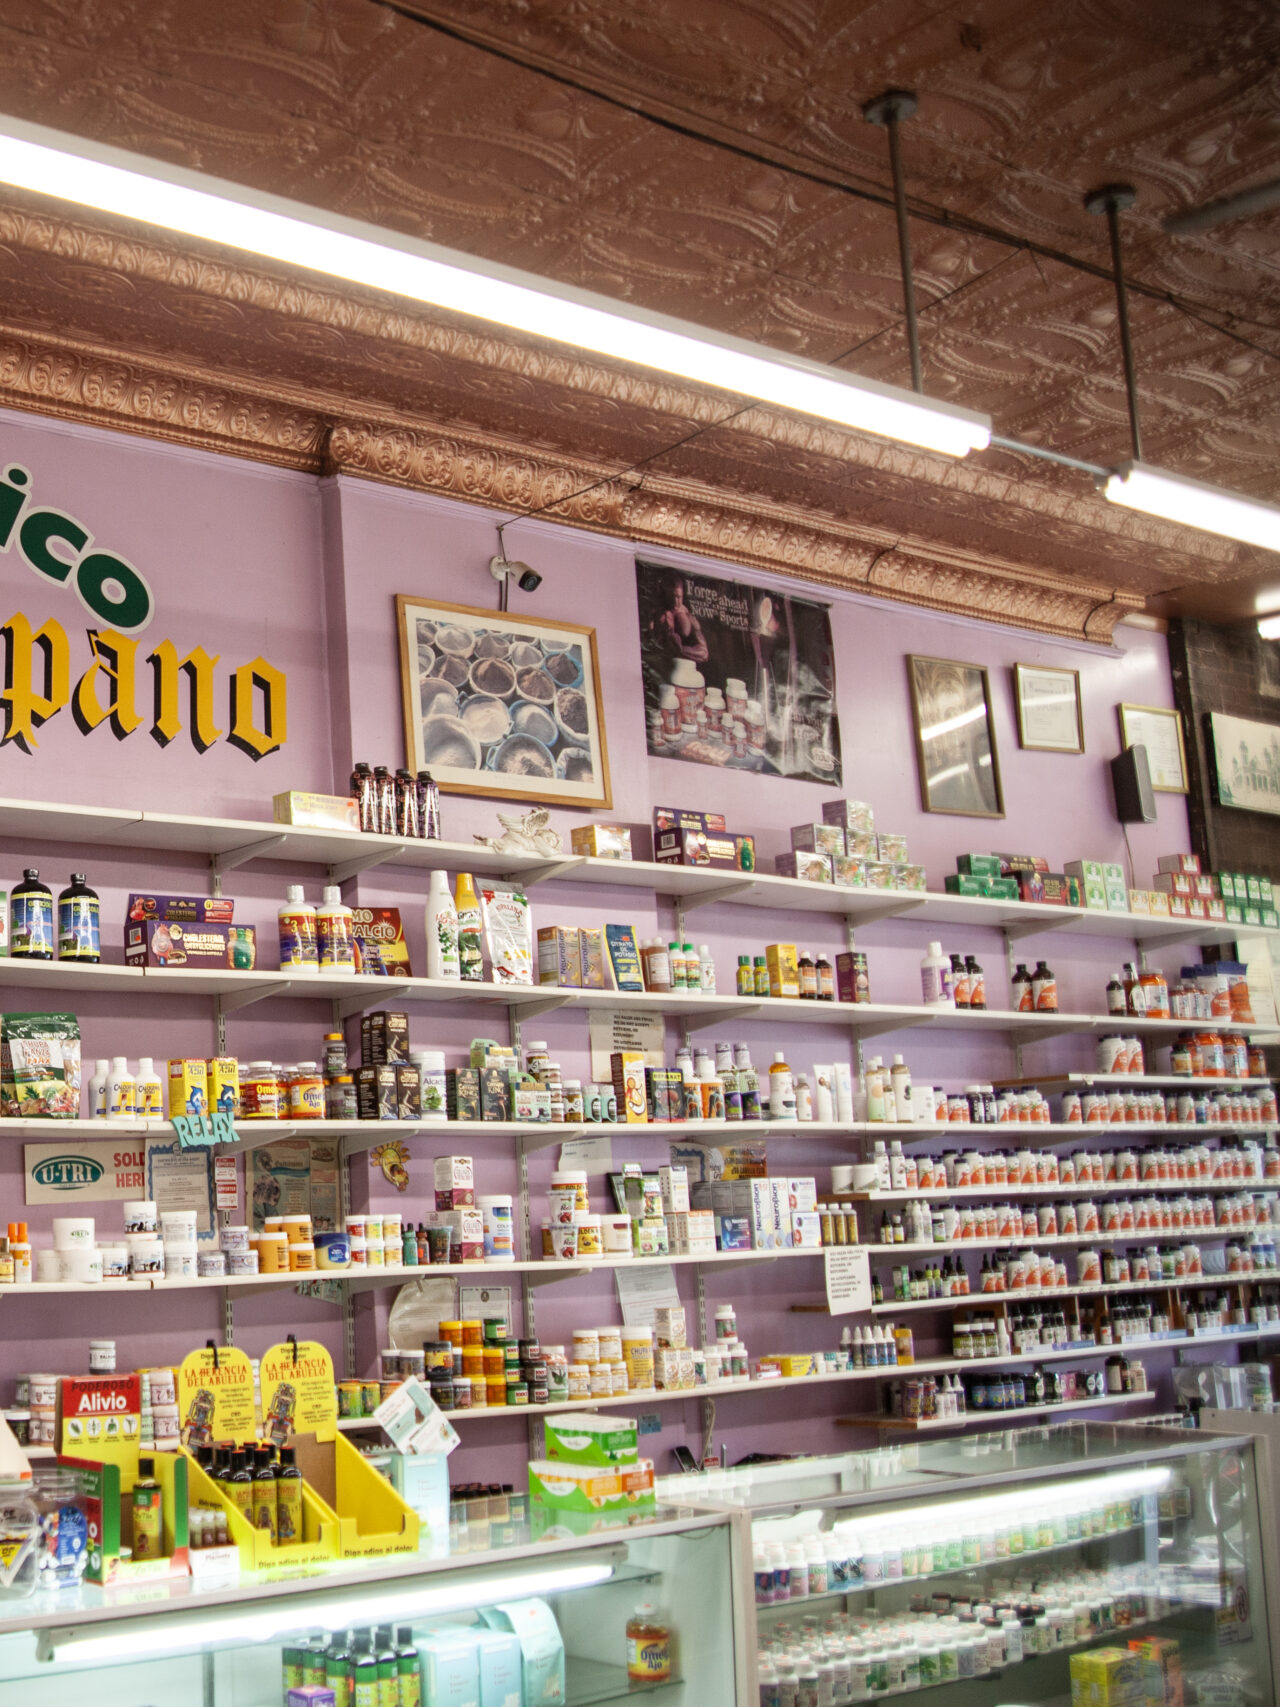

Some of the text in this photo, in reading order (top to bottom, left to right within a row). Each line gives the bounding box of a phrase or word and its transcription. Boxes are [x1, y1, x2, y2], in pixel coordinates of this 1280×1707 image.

[685, 579, 718, 603] Forge
[718, 593, 749, 611] ahead
[720, 611, 749, 627] Sports
[290, 920, 298, 933] 3
[321, 921, 328, 934] 3
[172, 1112, 241, 1148] RELAX
[41, 1162, 94, 1184] U-TRI
[115, 1172, 145, 1189] HER
[184, 1364, 248, 1379] LA HERENCIA
[265, 1358, 328, 1373] LA HERENCIA
[187, 1374, 247, 1388] DEL ABUELO
[268, 1367, 327, 1382] DEL ABUELO
[78, 1391, 127, 1412] Alivio
